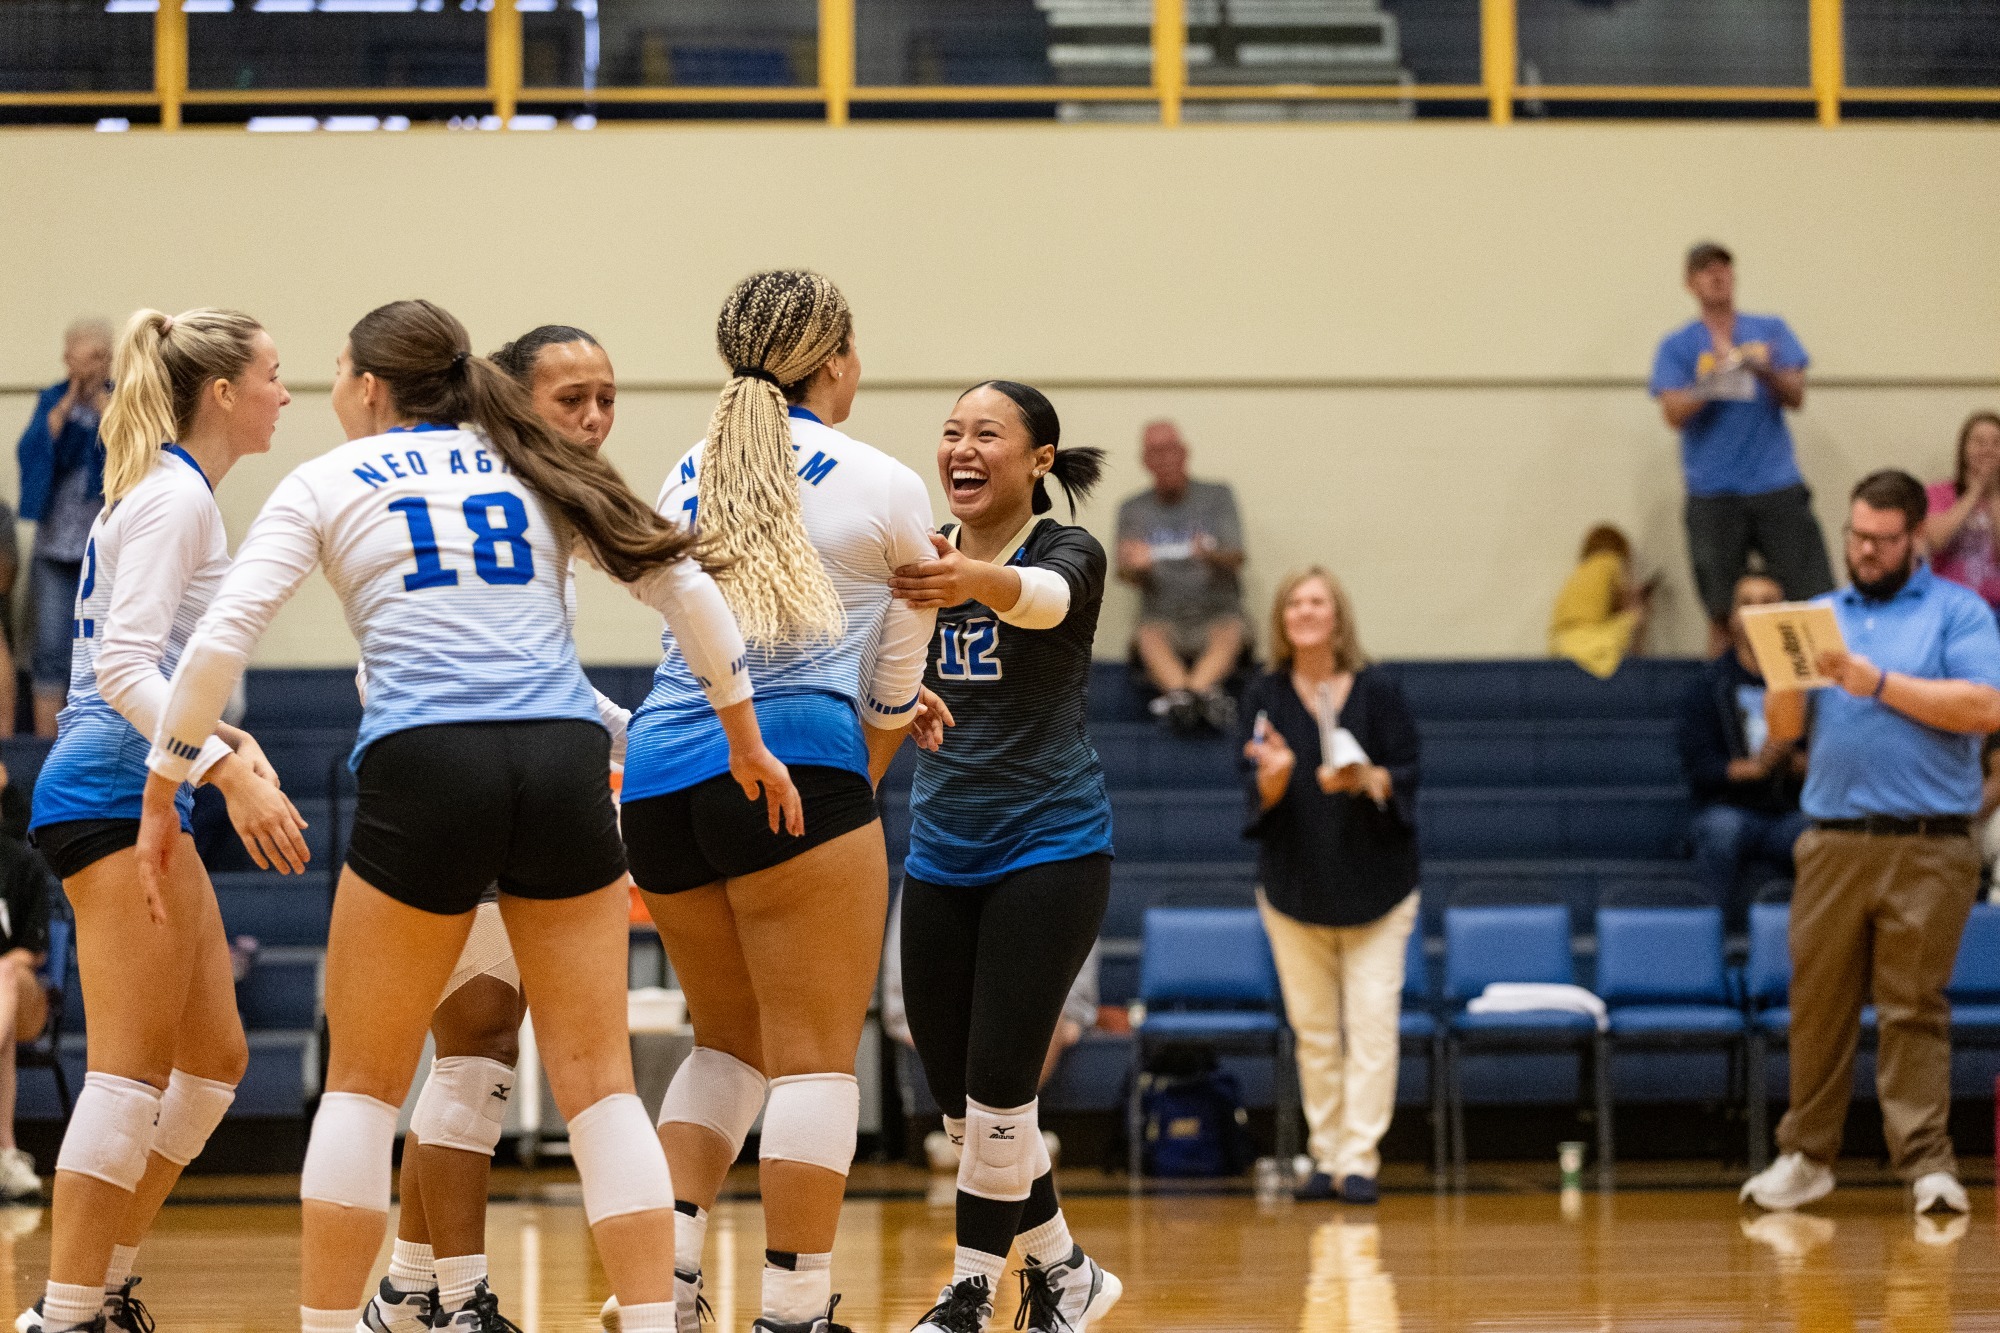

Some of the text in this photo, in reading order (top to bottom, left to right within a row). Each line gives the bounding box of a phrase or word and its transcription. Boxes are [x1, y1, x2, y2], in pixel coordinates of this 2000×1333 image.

[353, 449, 513, 489] NEO A&
[388, 491, 535, 593] 18
[936, 616, 1003, 681] 12
